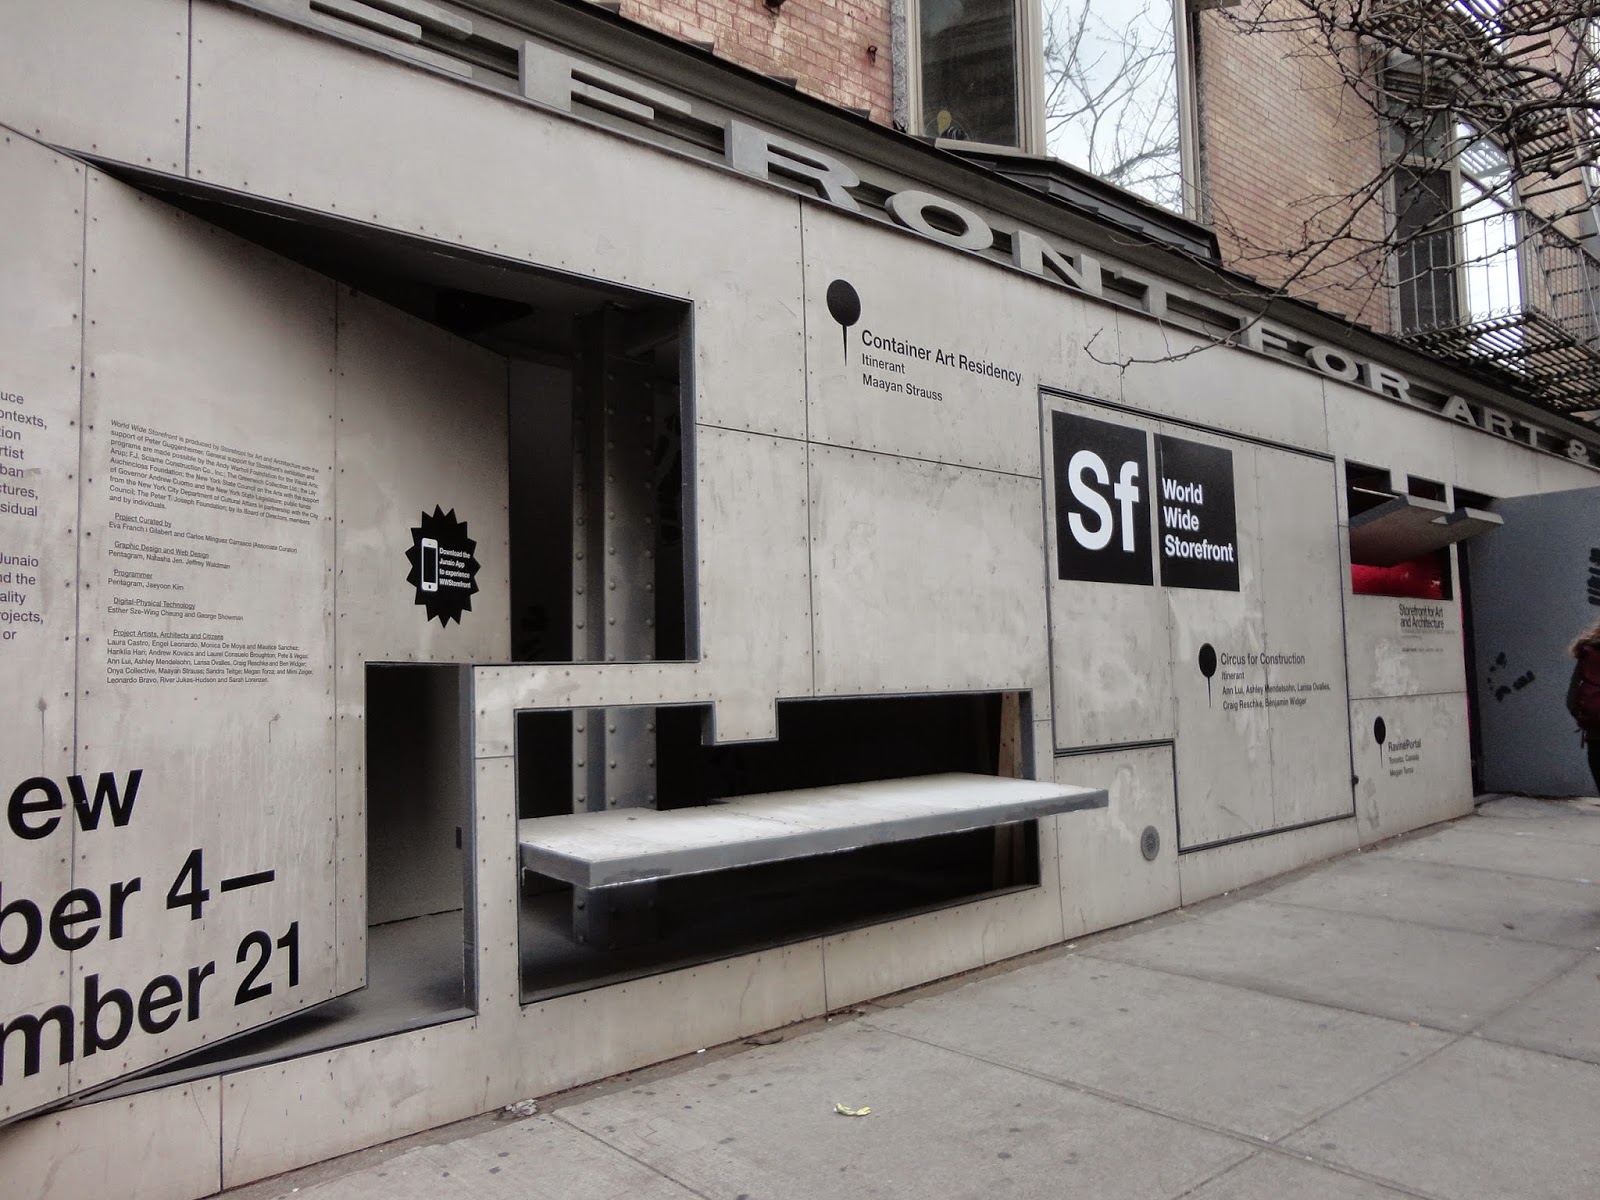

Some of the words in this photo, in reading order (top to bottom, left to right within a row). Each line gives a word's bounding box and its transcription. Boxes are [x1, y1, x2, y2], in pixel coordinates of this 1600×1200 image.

[862, 330, 931, 361] Container
[935, 349, 955, 368] Art
[959, 355, 1022, 386] Residency
[862, 353, 905, 374] Itinerant
[862, 373, 903, 394] Maayan
[906, 383, 943, 402] Strauss
[1241, 316, 1411, 401] FOR
[1441, 394, 1547, 450] ART
[0, 426, 21, 441] ion
[111, 420, 129, 429] World
[131, 425, 146, 433] Wide
[148, 429, 177, 440] Storefront
[111, 430, 135, 440] support
[144, 437, 161, 445] Peter
[111, 440, 141, 450] programs
[118, 468, 147, 478] Governor
[110, 475, 124, 483] from
[153, 483, 166, 491] York
[1162, 478, 1203, 505] World
[1068, 450, 1139, 553] Sf
[1163, 506, 1200, 531] Wide
[122, 523, 144, 532] Franch
[114, 541, 139, 550] Graphic
[141, 544, 161, 553] Design
[1165, 534, 1234, 562] Storefront
[16, 573, 36, 585] the
[113, 569, 153, 579] Programmer
[3, 630, 17, 640] or
[1221, 653, 1246, 666] Circus
[1248, 653, 1258, 665] for
[1260, 653, 1305, 665] Construction
[1222, 671, 1245, 680] Itinerant
[1222, 686, 1233, 695] Ann
[8, 769, 143, 840] ew
[234, 921, 299, 1006] 21
